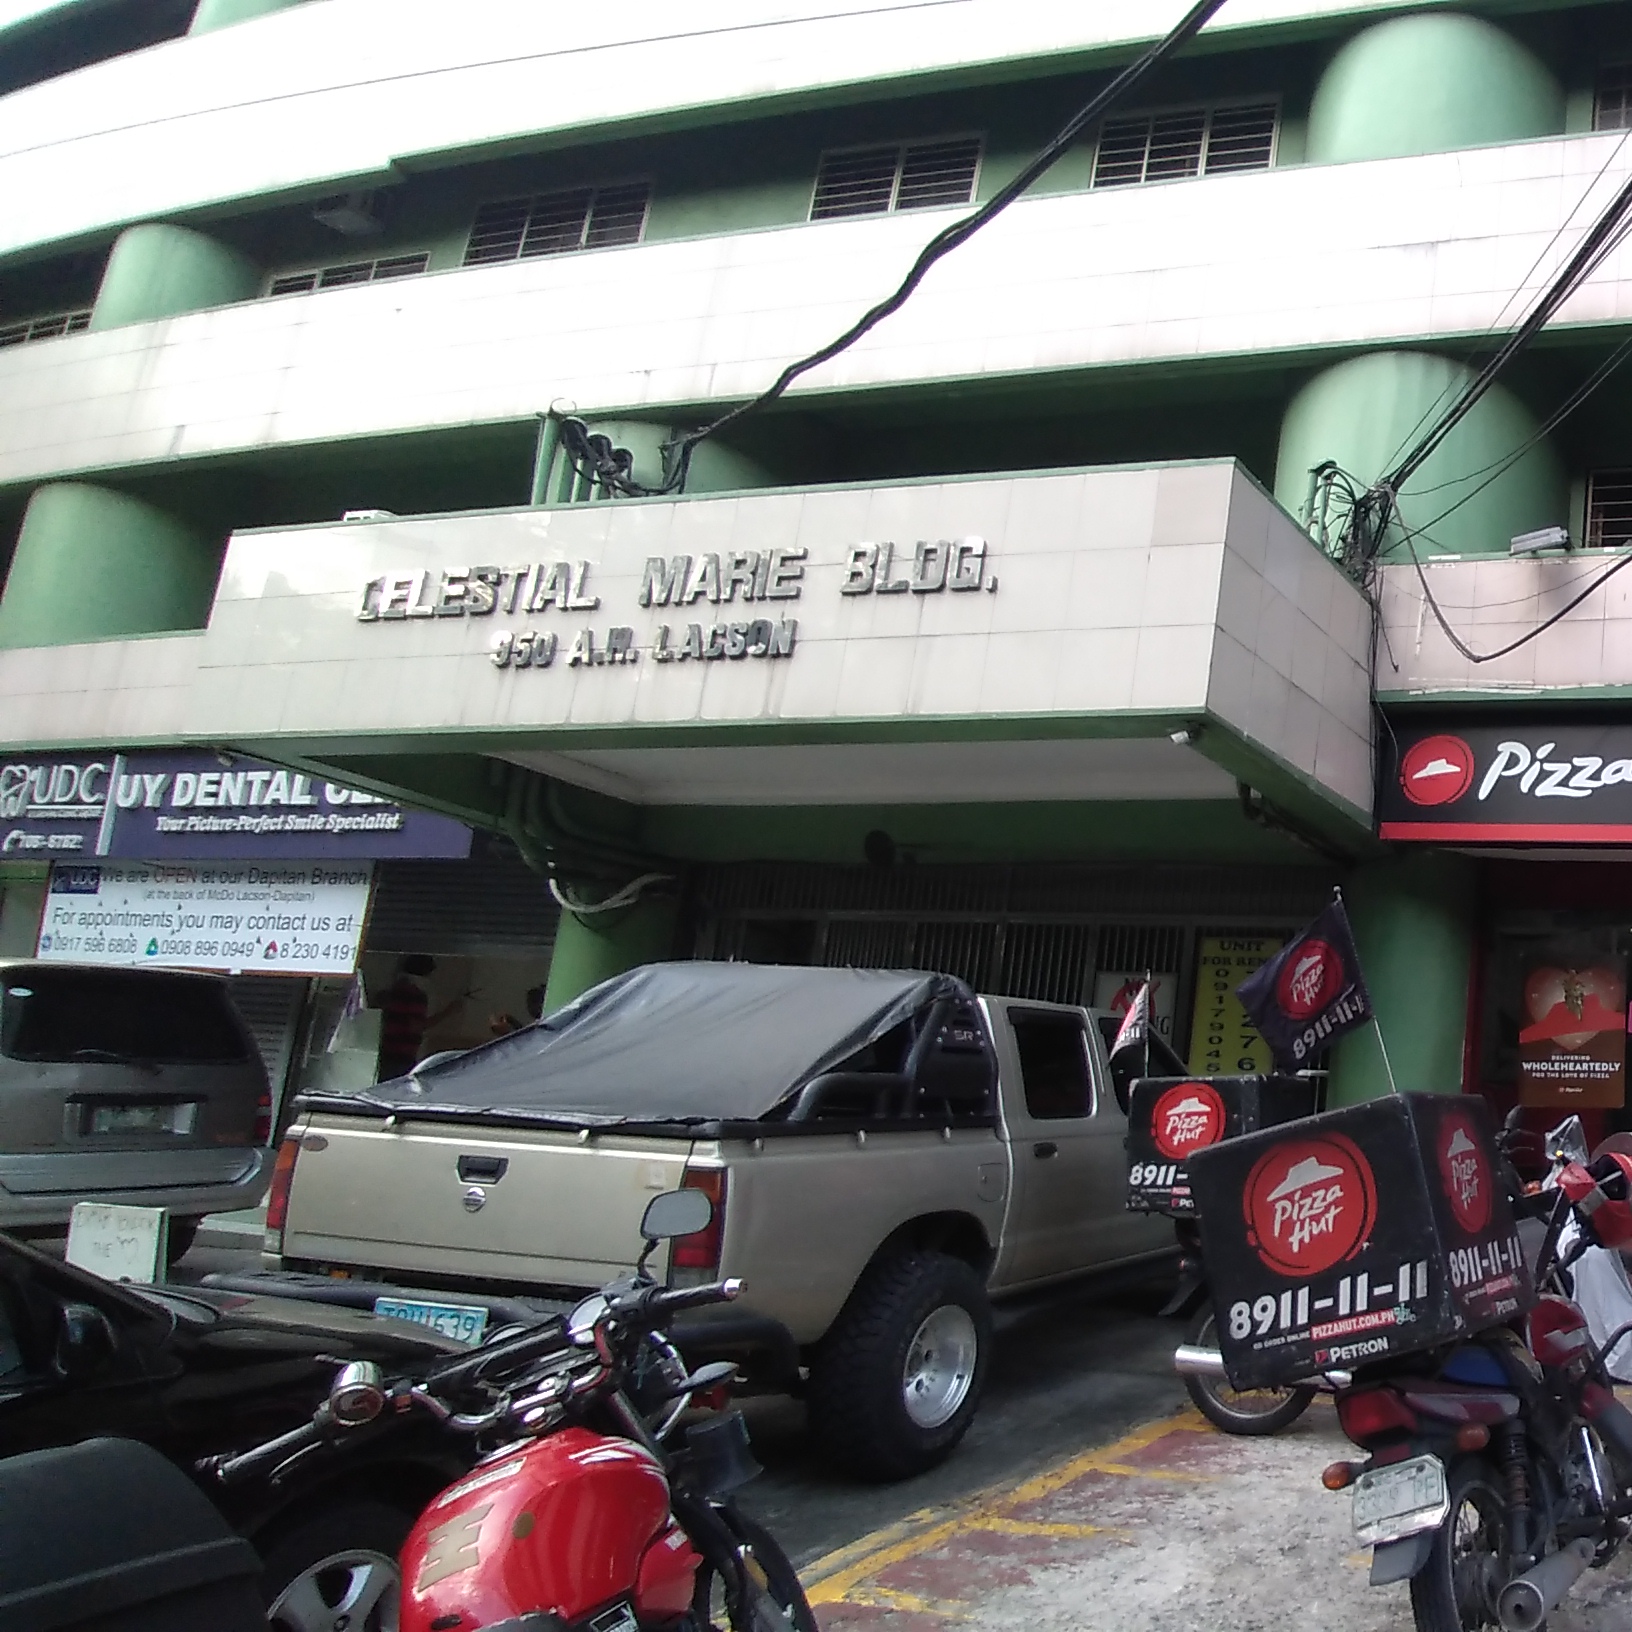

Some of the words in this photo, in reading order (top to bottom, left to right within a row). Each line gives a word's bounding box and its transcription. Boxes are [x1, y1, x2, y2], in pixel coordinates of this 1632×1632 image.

[357, 560, 600, 621] CELESTIAL
[641, 547, 808, 607] MARIE
[841, 537, 999, 596] BLDG.
[651, 617, 799, 663] LACSON
[34, 763, 107, 804] UDC
[116, 773, 168, 807] UY
[171, 771, 316, 806] DENTAL
[156, 815, 187, 831] Your
[187, 814, 285, 834] Picture-Perfect
[285, 814, 326, 831] Smile
[127, 870, 150, 883] are
[154, 866, 198, 884] OPEN
[202, 869, 216, 884] at
[219, 872, 246, 884] our
[248, 868, 306, 889] Dapitan
[311, 868, 368, 885] Branch
[53, 907, 77, 925] For
[78, 909, 174, 930] appointments
[175, 913, 206, 934] you
[209, 914, 245, 934] may
[247, 913, 308, 931] contact
[310, 916, 331, 931] us
[335, 914, 353, 932] at
[292, 943, 320, 960] 230
[1219, 941, 1266, 952] UNIT
[1202, 957, 1232, 967] FOR
[1236, 957, 1267, 967] REN
[1292, 963, 1325, 1003] Pizza
[1521, 1061, 1621, 1072] WHOLEHEARTEDLY
[1165, 1113, 1209, 1135] Pizza
[1172, 1126, 1207, 1146] Hut
[1129, 1164, 1189, 1186] 8911-
[1451, 1156, 1479, 1190] Pizza
[1460, 1176, 1479, 1211] Hut
[1273, 1182, 1344, 1238] Pizza
[1288, 1204, 1344, 1253] Hut
[1449, 1236, 1523, 1288] 8911-11-11
[1229, 1259, 1429, 1340] 8911-11-11
[1311, 1309, 1396, 1339] PIZZAHUT.COM.PH
[1329, 1336, 1389, 1363] PETRON
